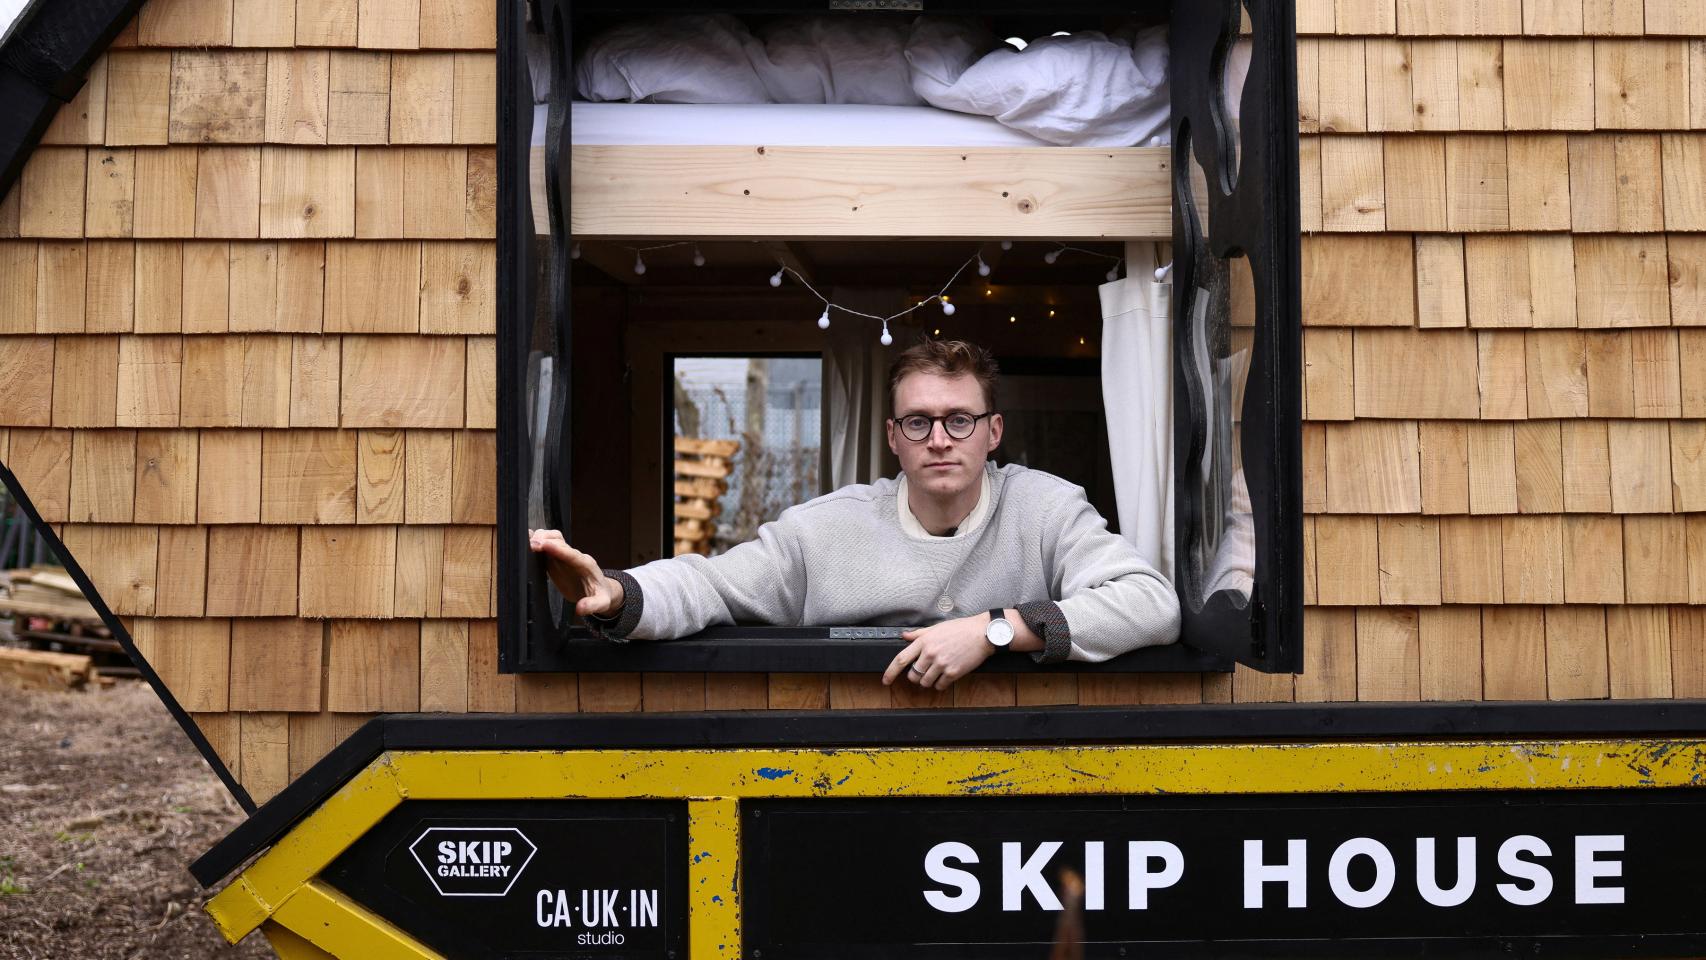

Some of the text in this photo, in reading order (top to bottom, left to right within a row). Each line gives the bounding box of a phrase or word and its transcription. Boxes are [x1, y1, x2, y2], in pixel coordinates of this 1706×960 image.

[437, 840, 512, 864] SKIP
[437, 865, 511, 878] GALLERY
[922, 834, 1626, 913] SKIP HOUSE
[577, 930, 625, 945] studio
